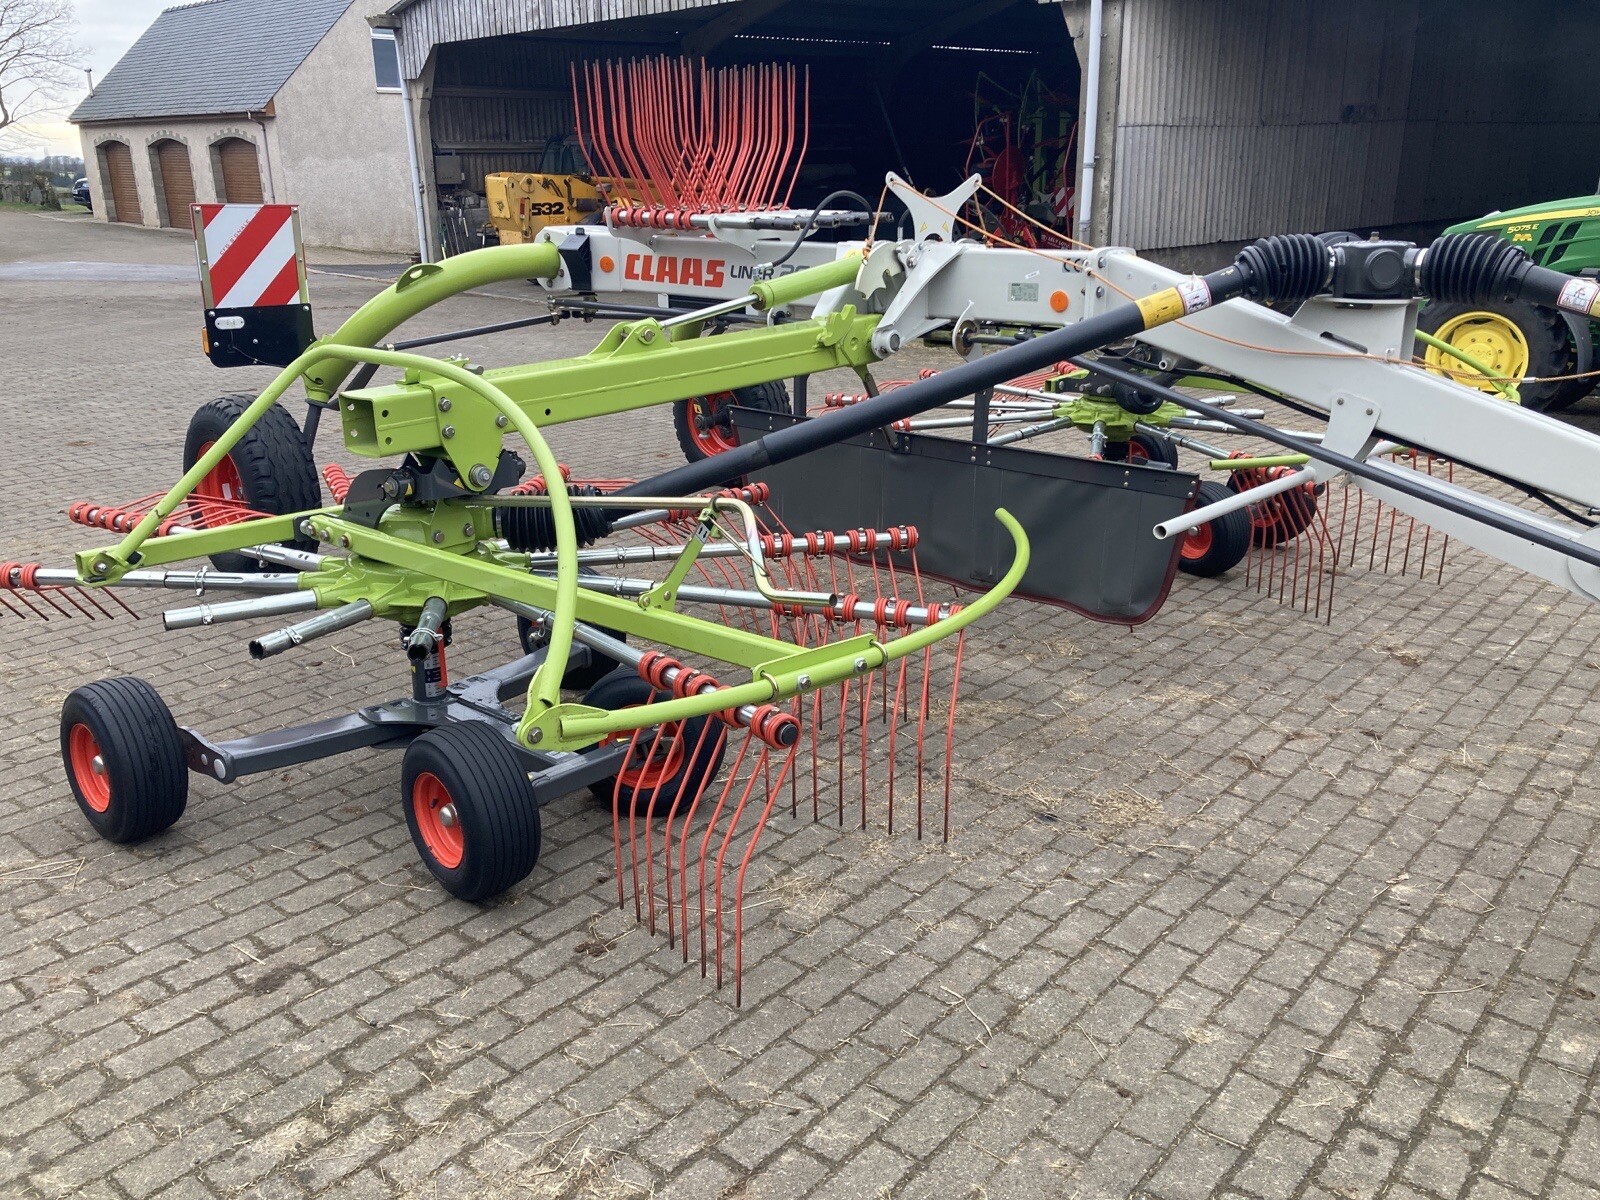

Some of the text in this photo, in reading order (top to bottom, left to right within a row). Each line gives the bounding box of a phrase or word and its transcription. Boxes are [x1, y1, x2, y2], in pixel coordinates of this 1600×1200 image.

[531, 202, 565, 216] 532
[1507, 225, 1531, 233] 5075
[624, 253, 725, 288] CLAAS
